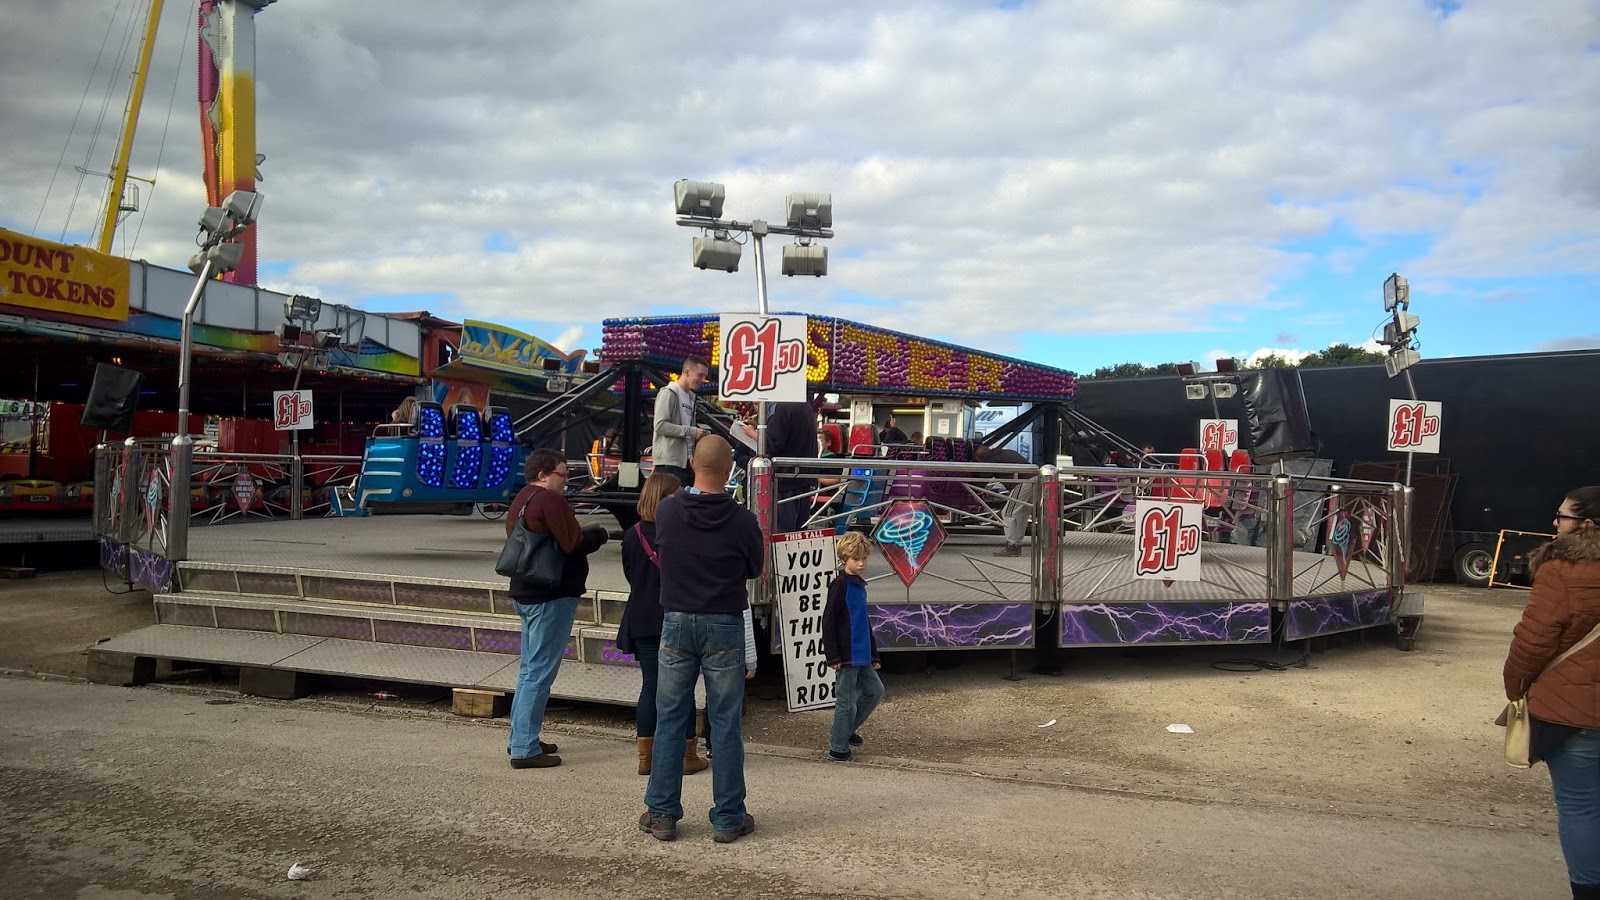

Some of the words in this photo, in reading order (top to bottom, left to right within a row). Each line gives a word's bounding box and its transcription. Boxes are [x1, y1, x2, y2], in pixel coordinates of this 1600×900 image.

[8, 269, 116, 308] TOKENS
[784, 533, 803, 541] THIS
[804, 530, 825, 539] TALL
[787, 549, 823, 570] YOU
[782, 570, 834, 594] MUST
[799, 593, 821, 613] BE
[789, 616, 824, 637] THI
[794, 640, 826, 659] TAL
[805, 660, 828, 680] TO
